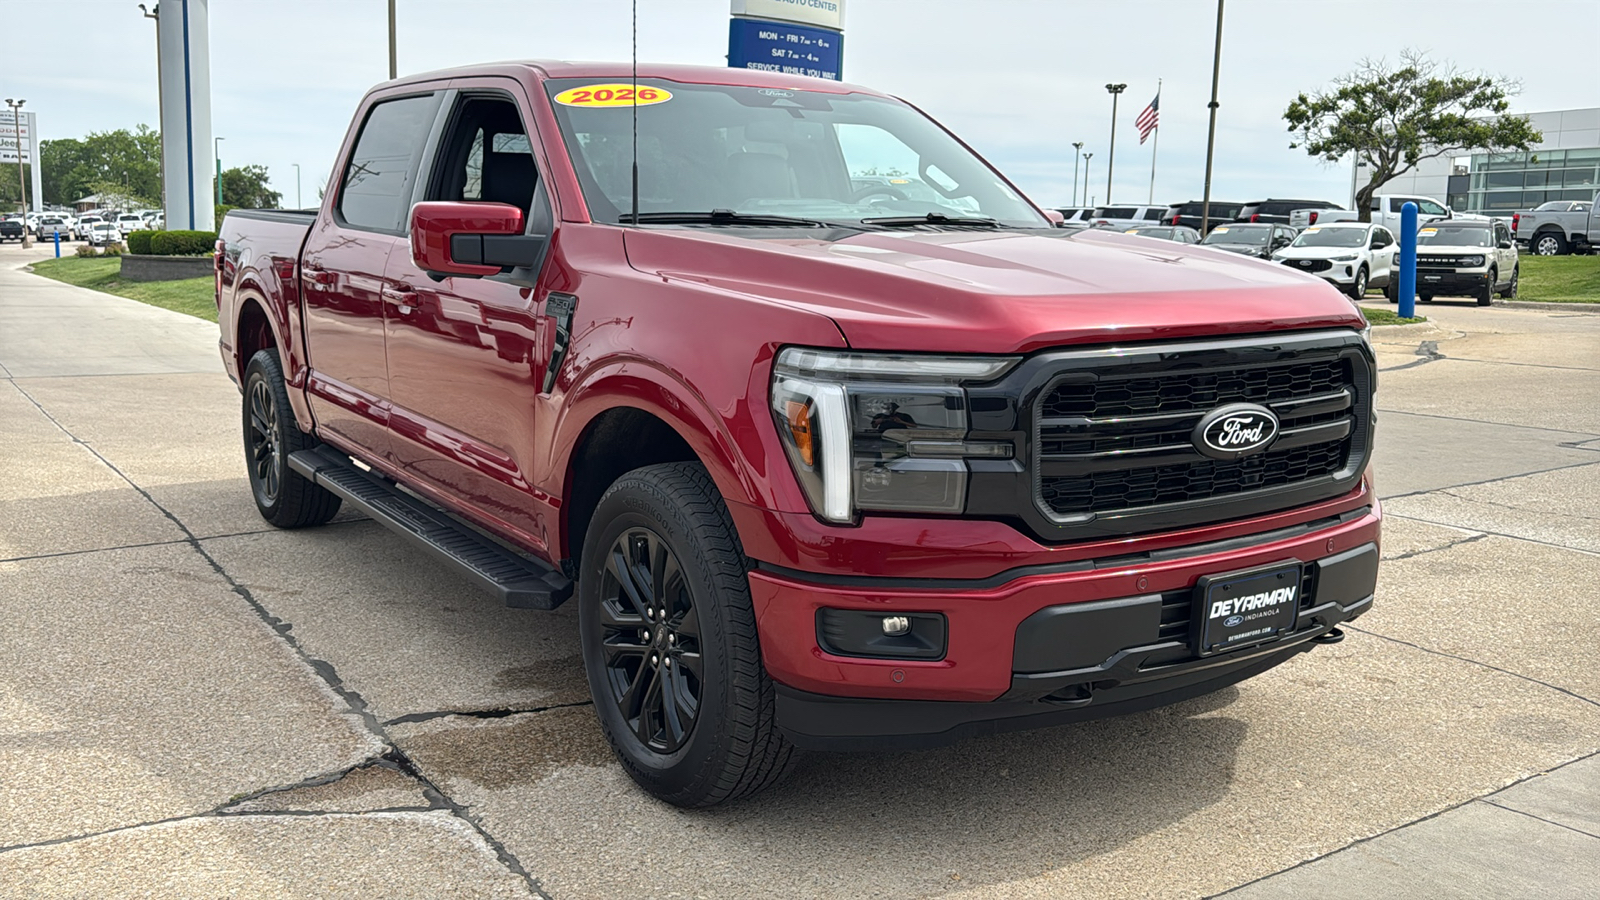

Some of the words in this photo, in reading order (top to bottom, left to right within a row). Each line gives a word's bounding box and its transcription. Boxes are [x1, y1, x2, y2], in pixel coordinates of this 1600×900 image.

[808, 0, 838, 12] CENTER
[759, 31, 778, 40] MON
[787, 34, 798, 43] FRI
[772, 48, 785, 57] SAT
[747, 62, 780, 73] SERVICE
[783, 66, 804, 76] WHILE
[807, 69, 820, 79] YOU
[822, 71, 836, 80] WAIT
[571, 89, 659, 104] 2026
[1218, 416, 1264, 446] Ford
[1209, 586, 1297, 619] DEYARMAN
[1244, 608, 1280, 621] INDIANOLA
